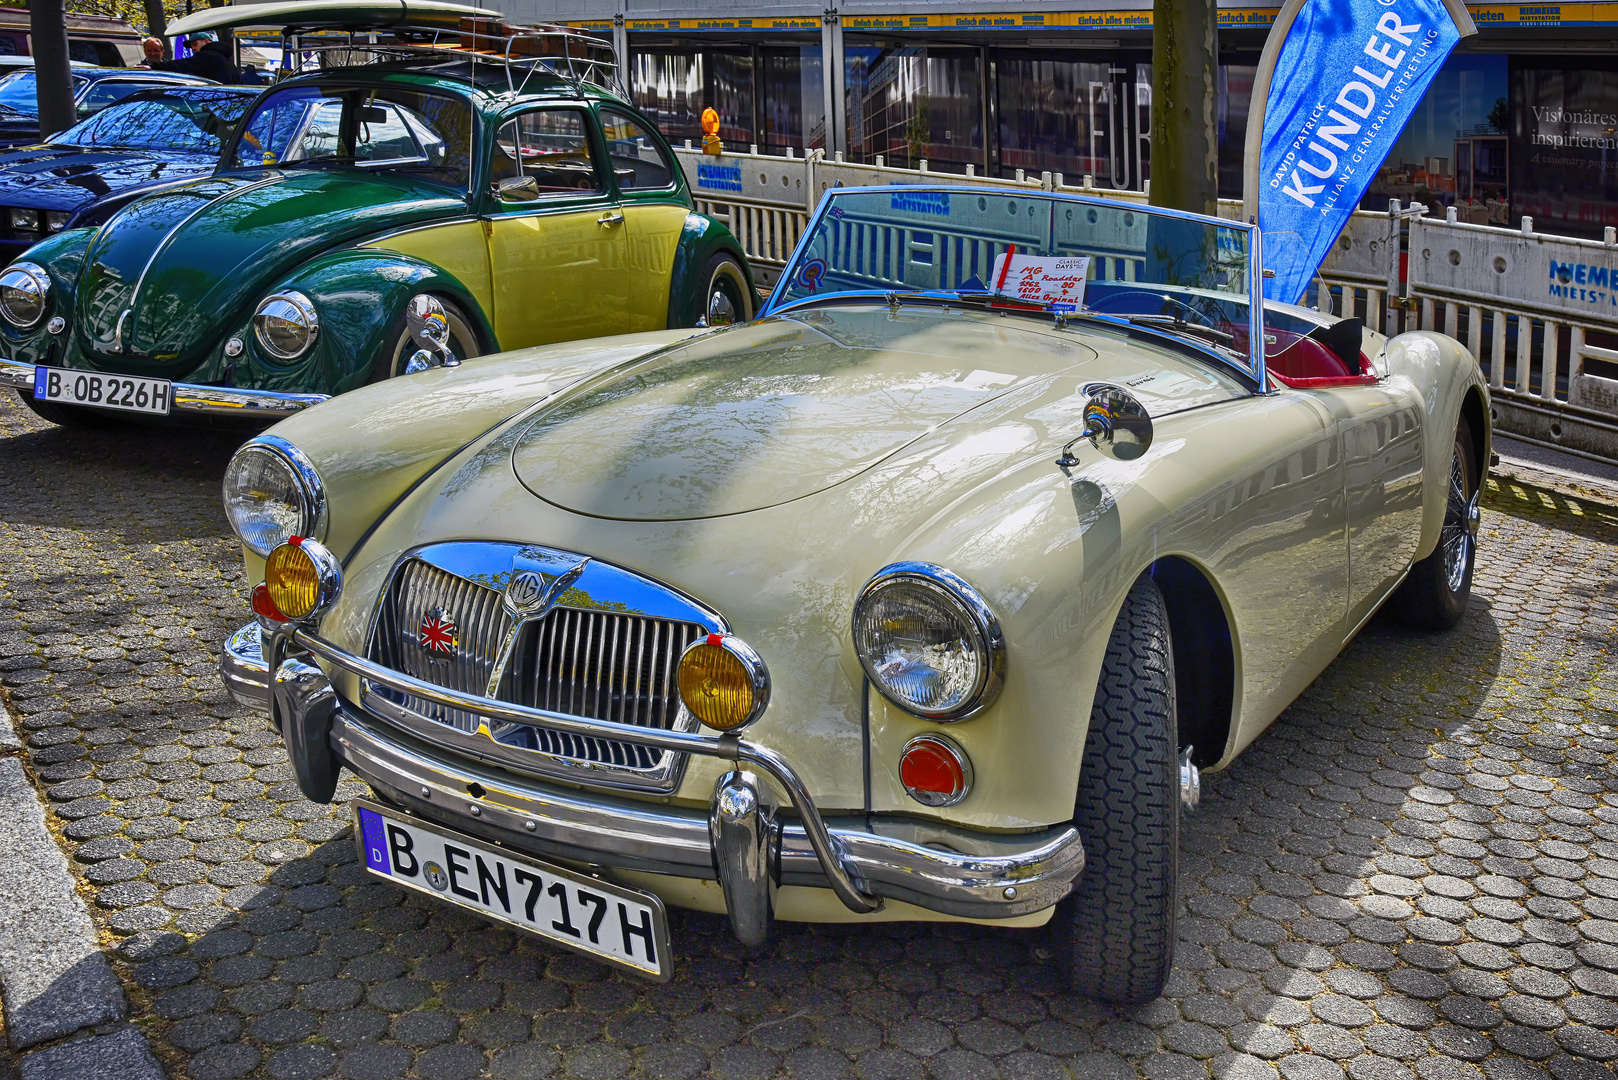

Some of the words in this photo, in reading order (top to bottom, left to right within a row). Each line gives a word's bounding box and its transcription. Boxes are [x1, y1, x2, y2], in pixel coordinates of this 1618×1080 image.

[1247, 13, 1268, 22] alles
[1519, 7, 1561, 15] NIEMEIER
[956, 17, 977, 26] Einfach
[978, 17, 992, 25] alles
[994, 17, 1015, 25] mieten
[1078, 16, 1104, 25] Einfach
[1105, 15, 1122, 25] alles
[1124, 15, 1150, 24] mieten
[1282, 11, 1422, 209] KUNDLER
[1532, 105, 1617, 126] Visionäres
[1320, 165, 1355, 217] ALLIANZ
[1352, 29, 1438, 163] GENERALVERTRETUNG
[1270, 151, 1296, 188] DAVID
[1293, 102, 1326, 151] PATRICK
[1531, 128, 1618, 150] inspirieren
[698, 178, 742, 192] MIETSTATION
[891, 197, 950, 216] MIETSTATION
[1020, 266, 1043, 275] MG
[1041, 274, 1084, 282] Roadster
[1042, 293, 1079, 304] Orginal
[37, 386, 44, 394] D
[47, 372, 62, 398] B
[512, 574, 539, 600] MG
[372, 848, 382, 863] D
[387, 823, 419, 878] B
